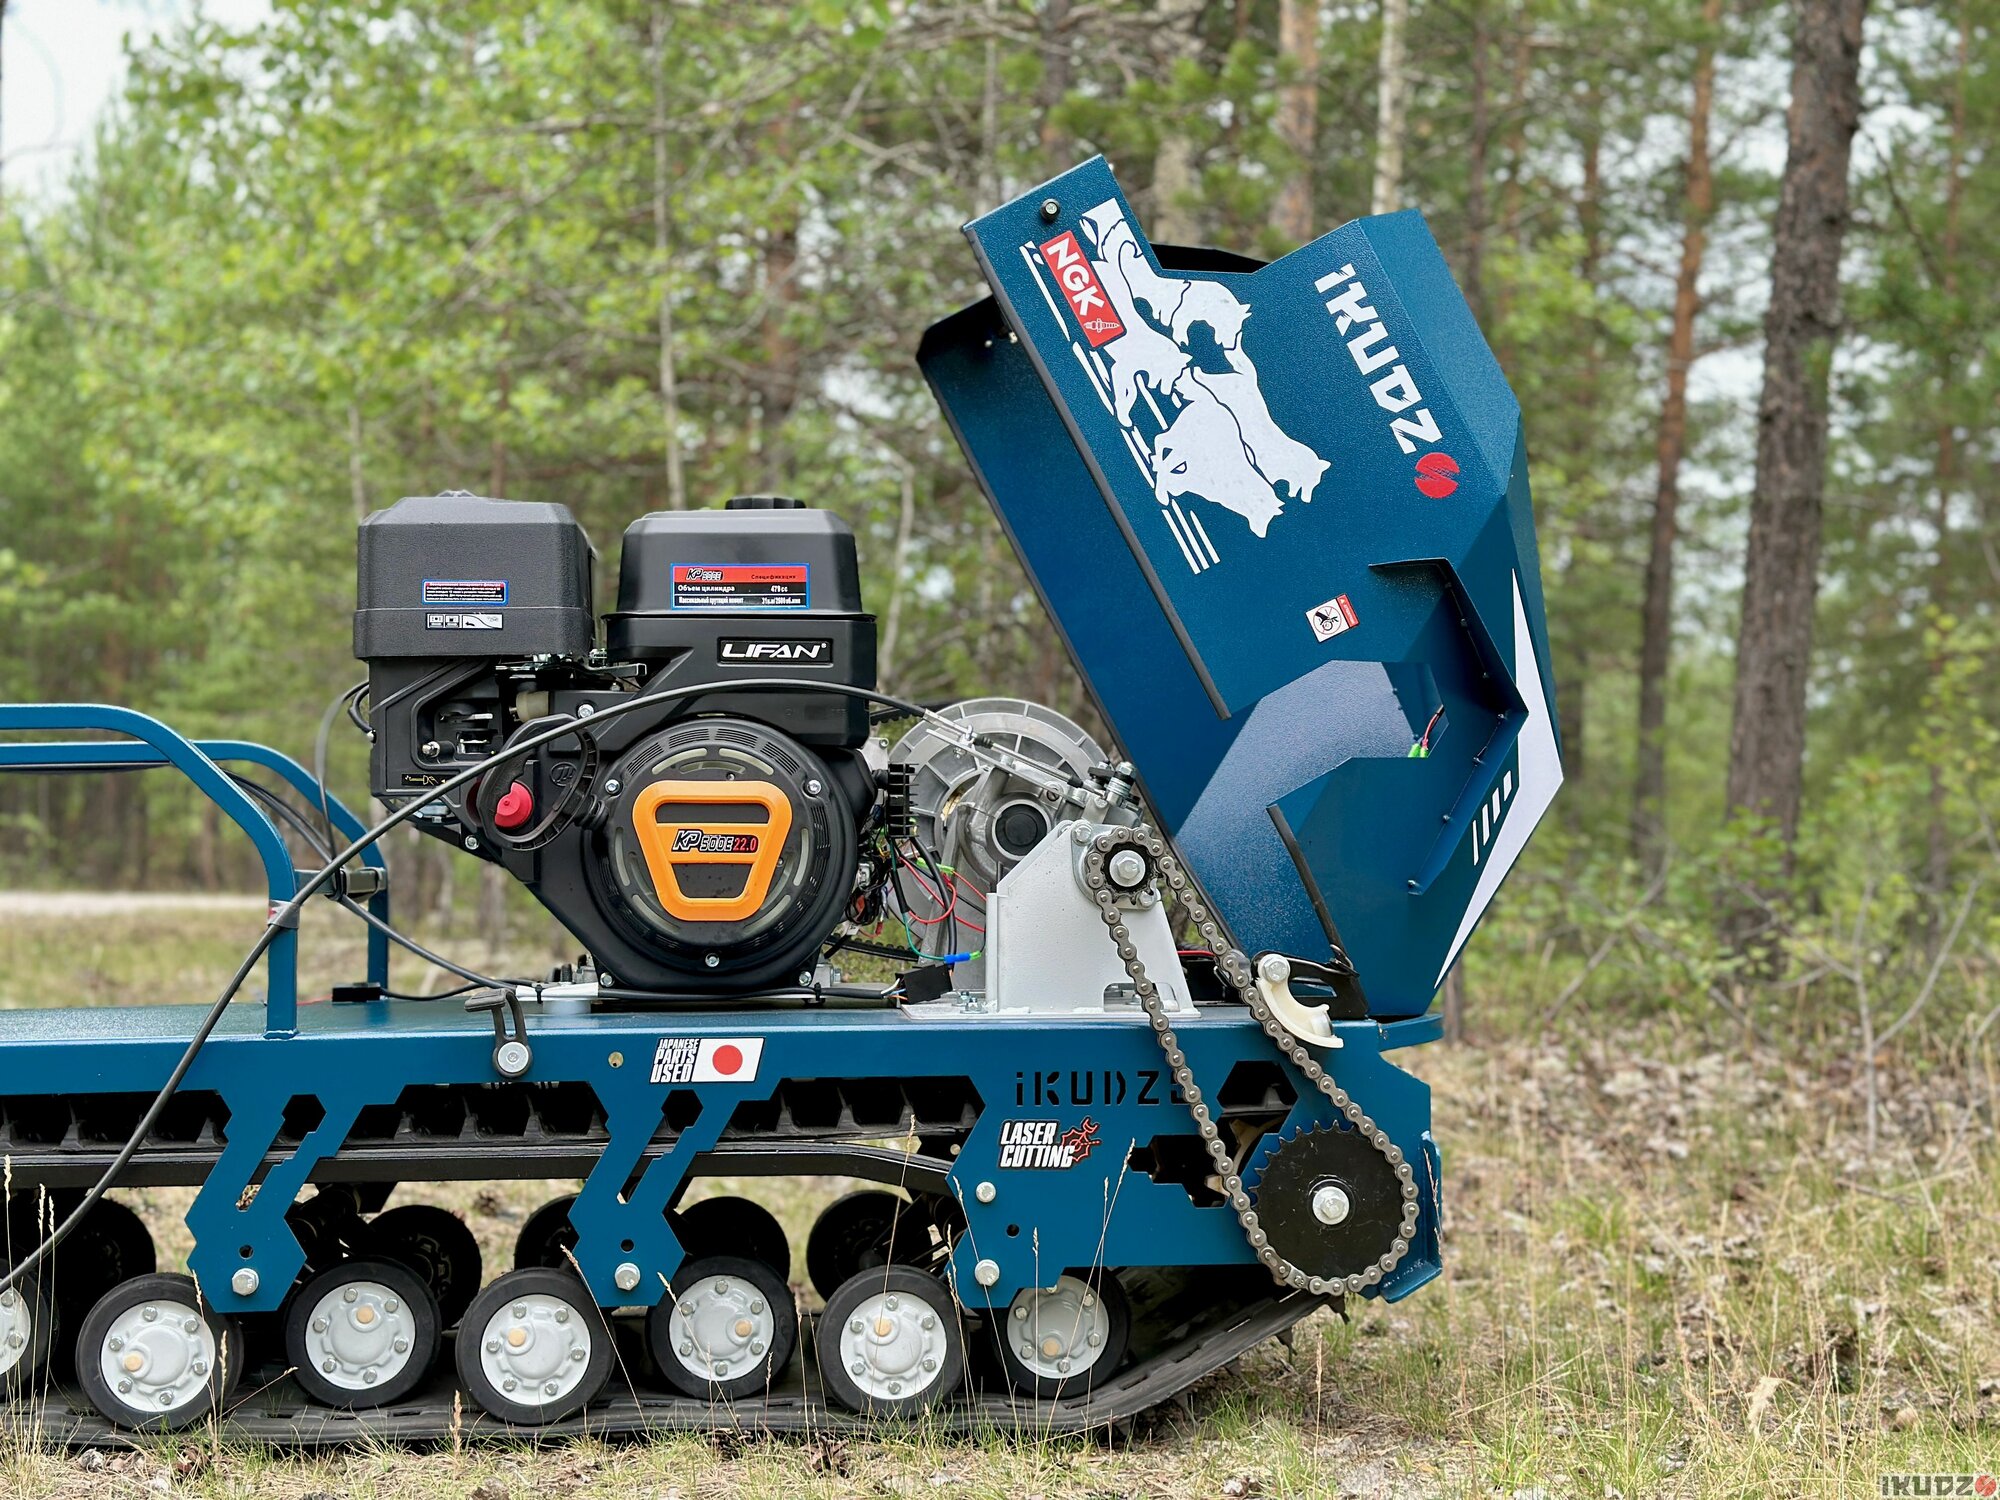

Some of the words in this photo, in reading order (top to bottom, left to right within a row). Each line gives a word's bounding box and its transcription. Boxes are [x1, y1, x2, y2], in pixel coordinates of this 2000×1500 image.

[1046, 237, 1105, 316] NGK
[733, 837, 757, 851] 22.0
[659, 1038, 700, 1049] JAPANESE
[654, 1048, 697, 1064] PARTS
[650, 1063, 693, 1083] USED
[1000, 1122, 1057, 1145] LASER
[1000, 1145, 1074, 1168] CUTTING
